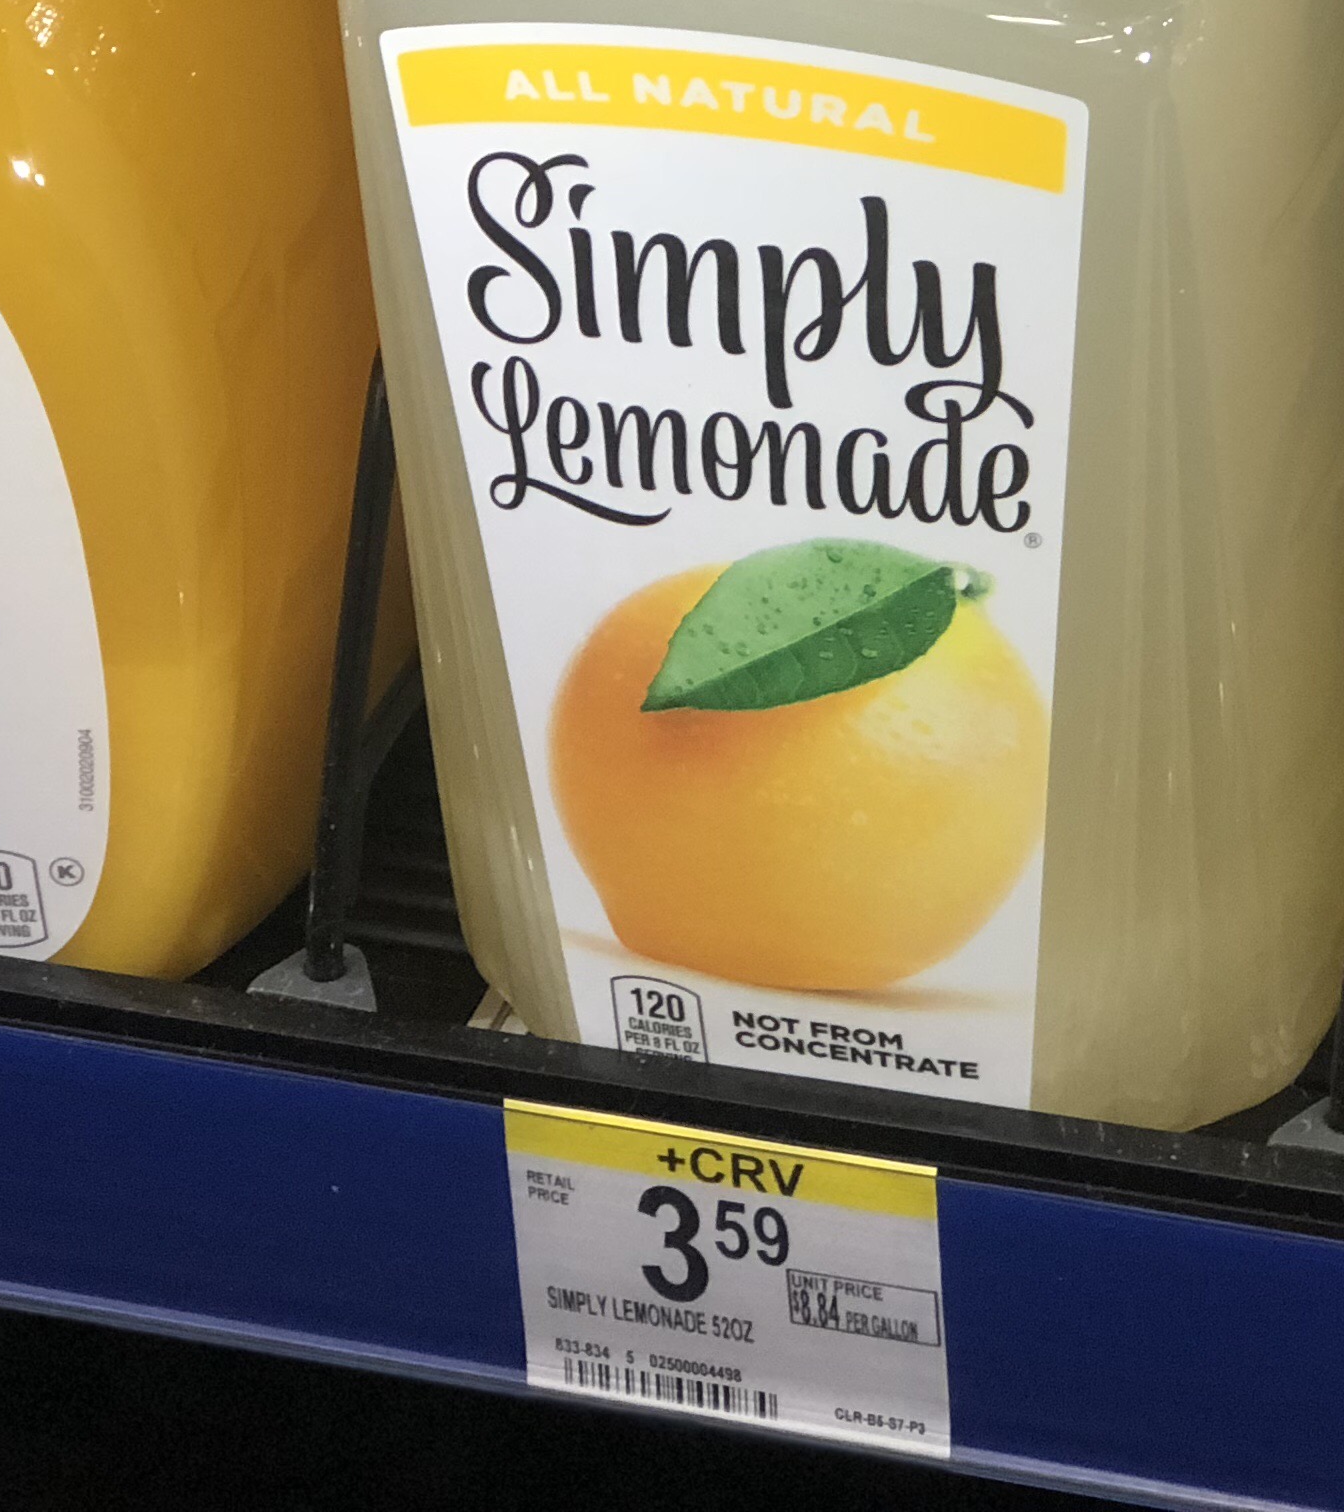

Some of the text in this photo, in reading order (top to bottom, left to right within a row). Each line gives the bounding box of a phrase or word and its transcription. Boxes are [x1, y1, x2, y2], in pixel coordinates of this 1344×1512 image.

[505, 68, 936, 145] ALL NATURAL
[466, 150, 1034, 431] Simply
[470, 355, 1032, 535] Lemonade
[1, 909, 18, 923] FL
[19, 909, 38, 924] OZ
[630, 987, 686, 1023] 120
[624, 1029, 651, 1046] PER
[664, 1037, 681, 1052] FL
[683, 1040, 701, 1055] OZ
[628, 1016, 693, 1040] CALORIES
[732, 1010, 905, 1051] NOT FROM
[735, 1031, 981, 1080] CONCENTRATE
[527, 1169, 575, 1192] RETAIL
[657, 1147, 805, 1197] +CRV
[528, 1186, 570, 1207] PRICE
[637, 1185, 710, 1303] 3
[790, 1273, 884, 1302] UNIT PRICE
[547, 1286, 756, 1344] SIMPLY LEMONADE 52OZ
[791, 1291, 919, 1341] $8.84 PER GALLON
[625, 1349, 635, 1365] 5
